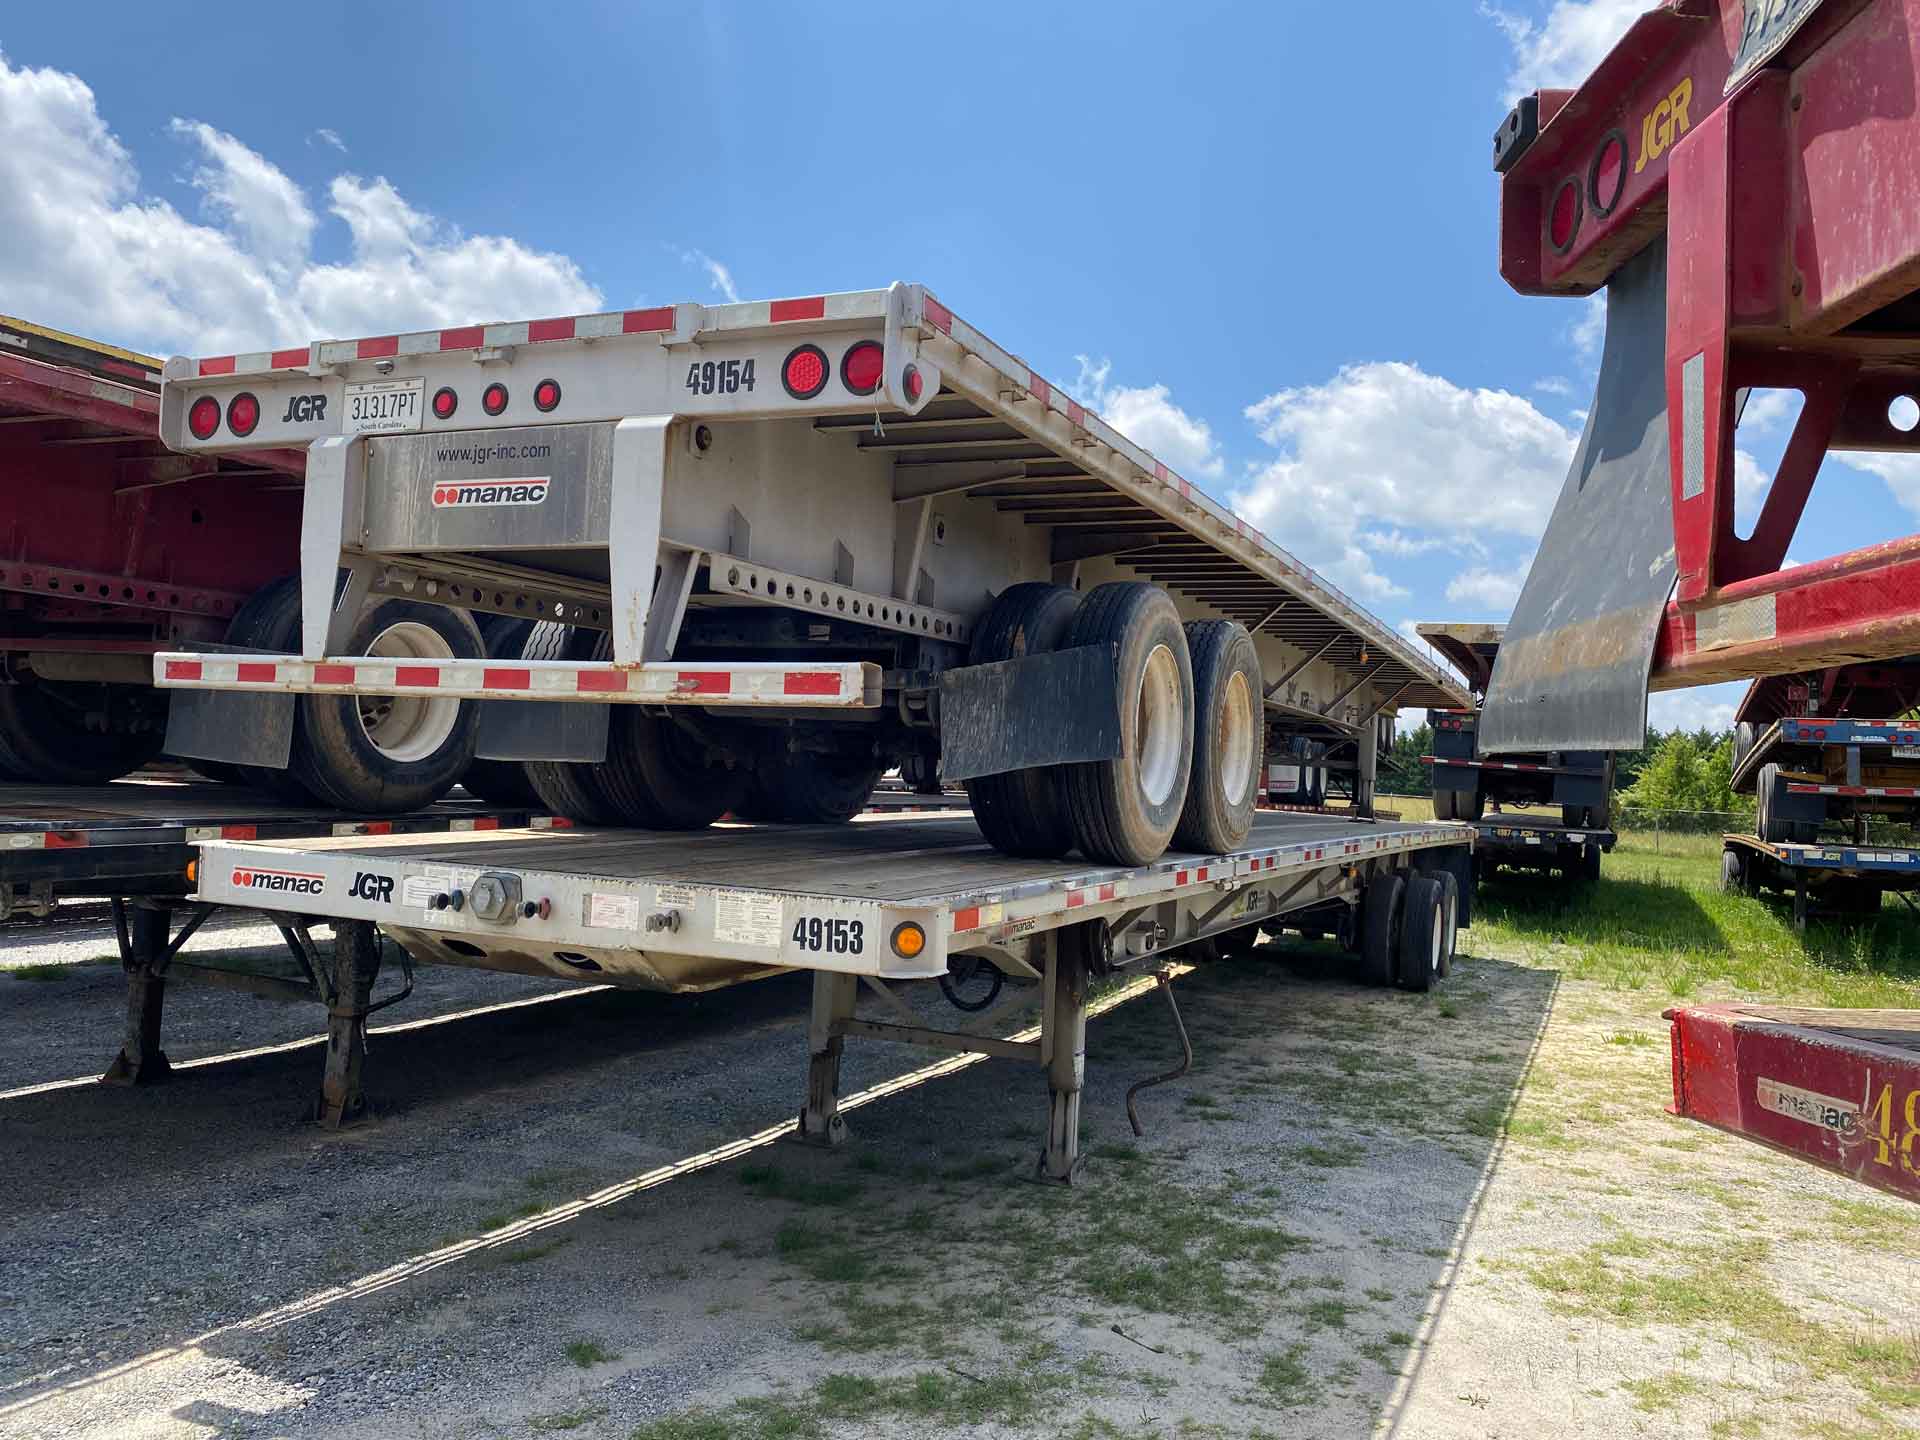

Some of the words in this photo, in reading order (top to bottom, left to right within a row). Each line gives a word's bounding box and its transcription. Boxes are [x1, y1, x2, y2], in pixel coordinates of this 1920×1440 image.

[1634, 76, 1694, 174] JGR
[685, 358, 756, 395] 49154
[282, 394, 328, 423] JGR
[352, 392, 417, 420] 31317PT
[437, 442, 551, 465] www.jgr-inc.com
[457, 484, 546, 504] manac
[251, 873, 324, 896] manac
[348, 871, 395, 904] JGR
[792, 917, 864, 955] 49153
[1011, 918, 1035, 936] manac
